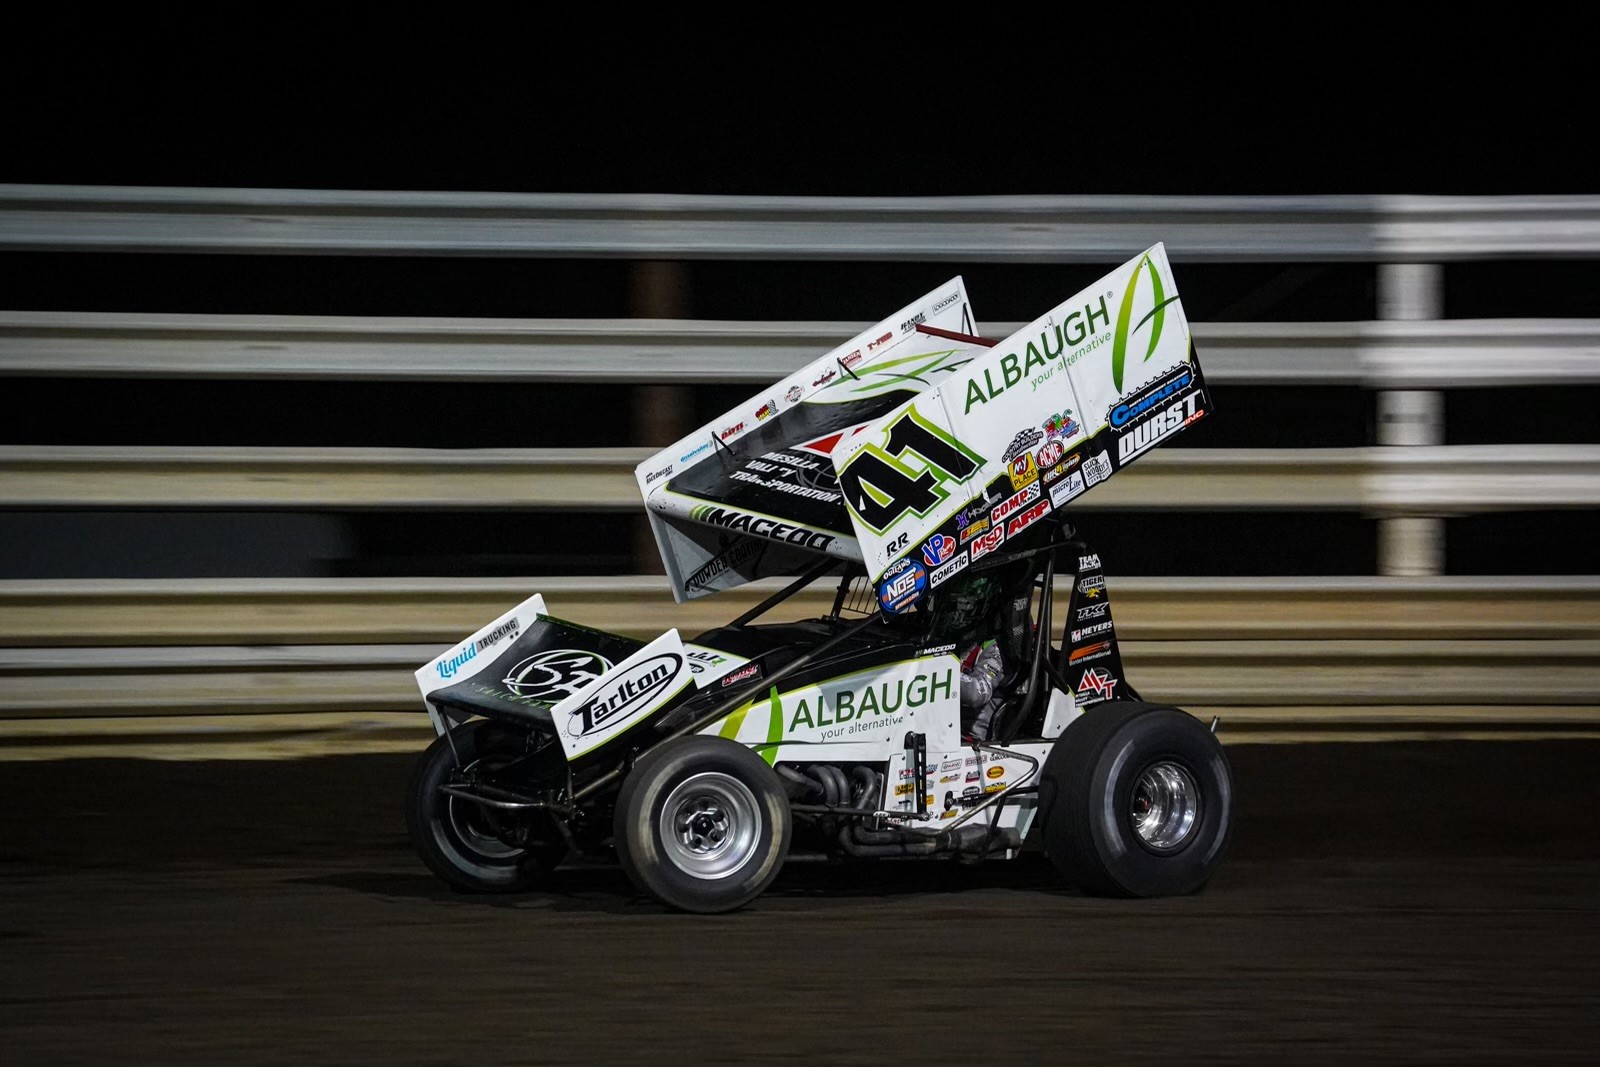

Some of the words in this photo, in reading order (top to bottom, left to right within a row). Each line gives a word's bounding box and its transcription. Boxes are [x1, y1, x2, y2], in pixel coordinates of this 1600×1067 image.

[965, 295, 1110, 415] ALBAUGH
[1031, 368, 1055, 392] your
[1056, 332, 1112, 371] alternative
[1111, 373, 1190, 426] COMPLETE
[1118, 388, 1201, 460] DURST
[1184, 409, 1204, 426] INC
[760, 451, 821, 470] MESILLA
[837, 406, 983, 533] 41
[1037, 442, 1063, 467] ACME
[729, 470, 842, 503] TRANSPORTATION
[1013, 468, 1036, 486] PLACE
[992, 489, 1028, 522] COMP
[1008, 499, 1049, 536] ARP
[707, 508, 836, 552] MACEDO
[886, 532, 909, 557] RR
[972, 525, 1003, 555] MSD
[922, 534, 944, 566] VP
[1078, 553, 1100, 565] TEAM
[886, 567, 918, 602] NOS
[931, 555, 967, 585] COMETIC
[1081, 576, 1104, 588] TIGER
[1081, 620, 1113, 636] MEYERS
[436, 641, 477, 678] Liquid
[479, 619, 517, 650] TRUCKING
[923, 643, 956, 655] MACEDO
[1082, 649, 1112, 662] International
[569, 663, 669, 736] Tarlton
[788, 668, 953, 733] ALBAUGH
[820, 726, 845, 742] your
[847, 715, 904, 734] alternative
